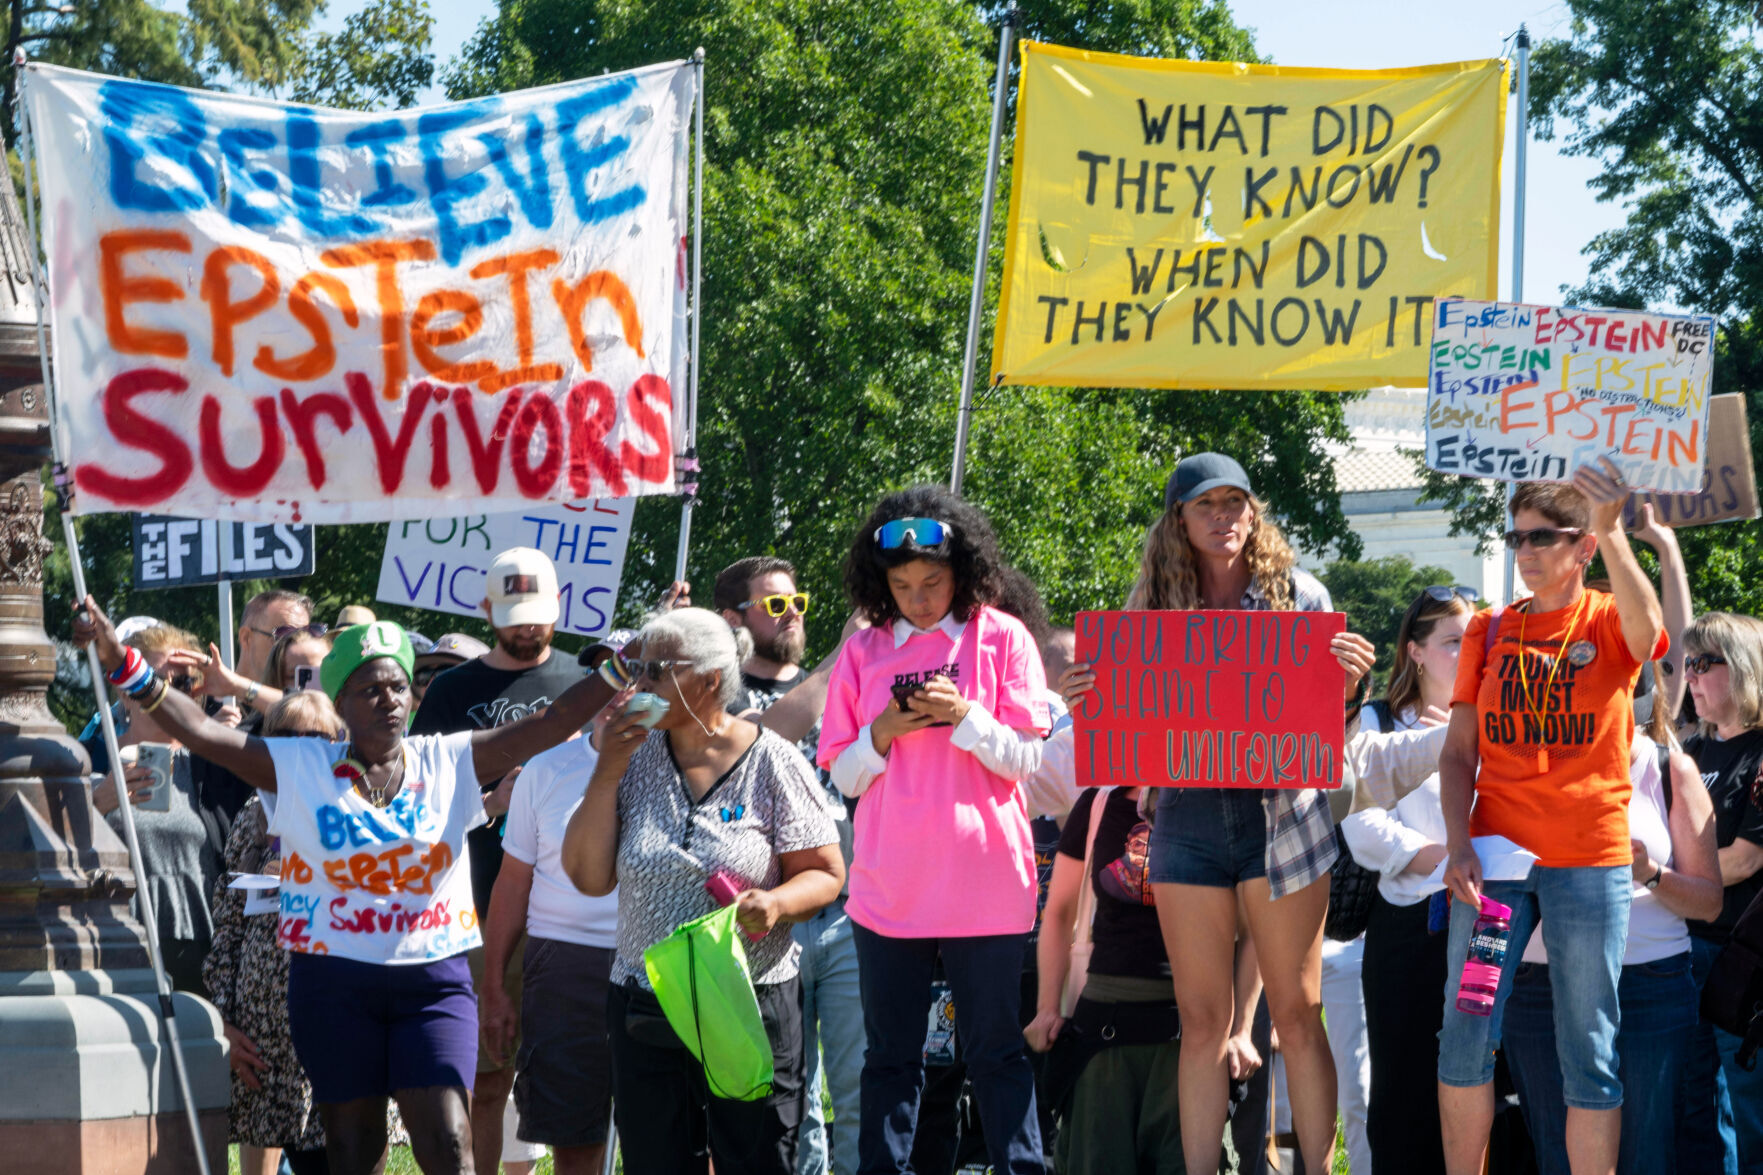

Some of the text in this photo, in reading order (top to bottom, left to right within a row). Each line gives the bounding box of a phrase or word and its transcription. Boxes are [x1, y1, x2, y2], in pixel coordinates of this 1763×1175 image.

[1137, 98, 1394, 157] WHAT DID
[100, 77, 647, 267] BELIEVE
[1077, 144, 1442, 219] THEY KNOW?
[1127, 233, 1388, 296] WHEN DID
[1037, 295, 1464, 347] THEY KNOW IT
[1671, 320, 1710, 338] FREE
[1676, 338, 1706, 354] DC
[1433, 340, 1551, 372] EPSTEIN
[1501, 381, 1699, 467] EPSTEIN
[167, 519, 304, 580] FILES
[523, 516, 618, 565] THE
[1083, 615, 1163, 665] YOU
[1498, 653, 1585, 681] TRUMP
[1082, 669, 1285, 723] SHAME TO
[1500, 681, 1575, 712] MUST
[1485, 711, 1595, 745] GO NOW!
[1085, 729, 1148, 782] THE
